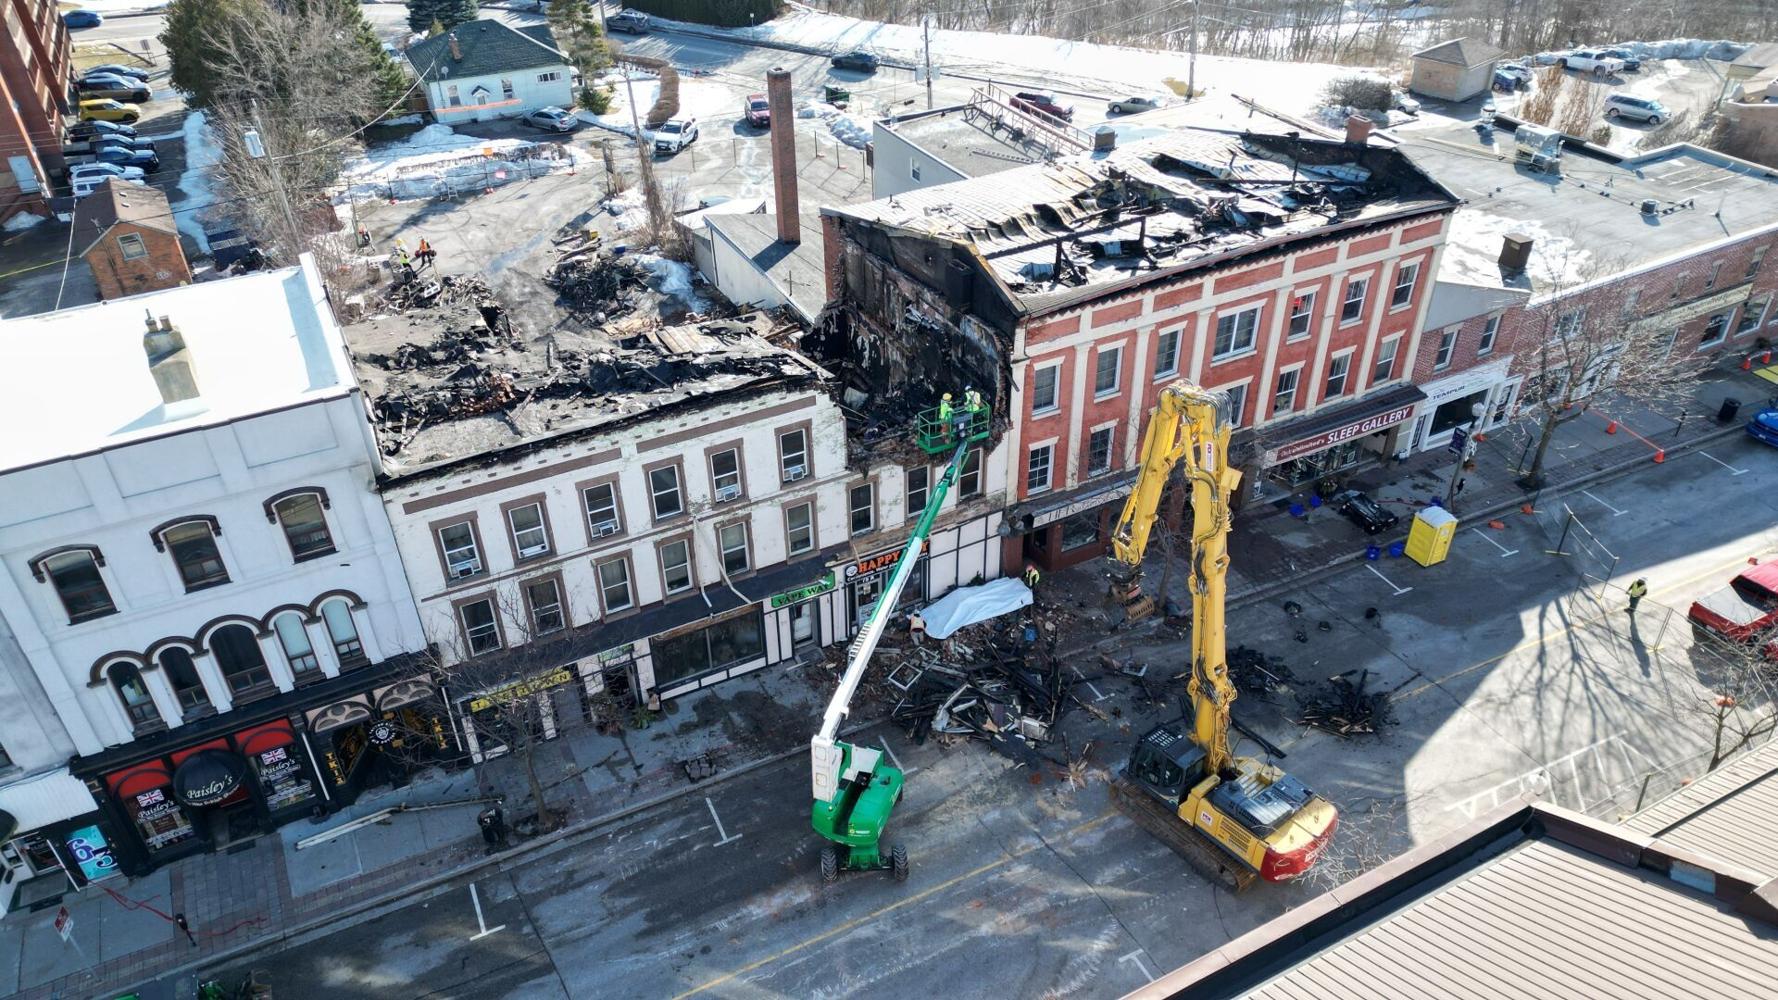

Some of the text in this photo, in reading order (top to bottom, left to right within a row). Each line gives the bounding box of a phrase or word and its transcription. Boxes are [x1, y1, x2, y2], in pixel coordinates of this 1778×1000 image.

[1327, 425, 1360, 445] SLEEP
[1361, 407, 1410, 433] GALLERY
[858, 550, 901, 574] HAPPY
[778, 590, 804, 604] VAPE
[259, 758, 296, 777] Paisley's
[186, 774, 233, 799] Paisley's
[137, 799, 175, 819] Paisley's
